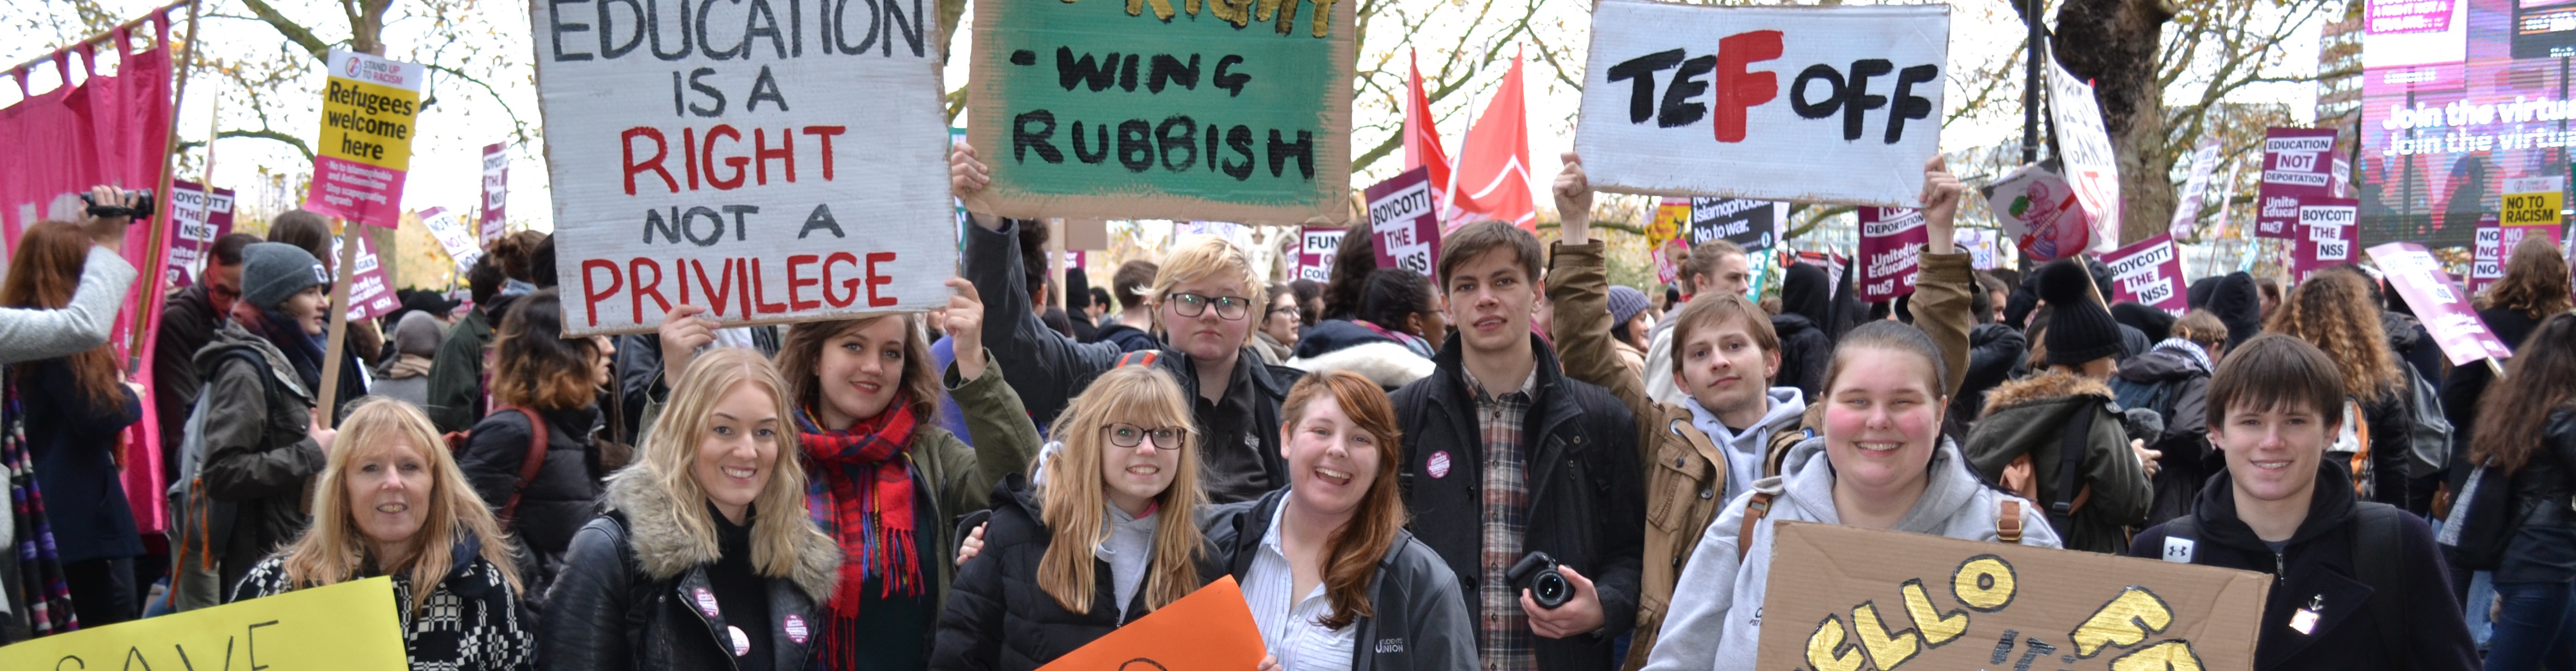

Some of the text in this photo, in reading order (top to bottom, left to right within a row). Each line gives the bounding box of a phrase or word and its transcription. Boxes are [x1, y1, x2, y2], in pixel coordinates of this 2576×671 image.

[550, 0, 925, 62] EDUCATION
[363, 60, 400, 74] STAND UP
[363, 70, 402, 85] TO RACISM
[328, 81, 413, 116] Refugees
[673, 64, 789, 117] IS A
[2382, 101, 2442, 130] Join
[2445, 100, 2494, 126] the
[328, 110, 407, 140] welcome
[342, 133, 384, 160] here
[1013, 109, 1315, 181] RUBBISH
[2269, 140, 2329, 150] EDUCATION
[621, 124, 846, 195] RIGHT
[2280, 155, 2313, 168] NOT
[2266, 173, 2325, 183] DEPORTATION
[173, 192, 229, 209] OYCOTT
[1373, 189, 1426, 225] BOYCOTT
[2507, 196, 2545, 209] NO TO
[178, 208, 202, 221] THE
[2262, 206, 2298, 218] Educat
[2302, 210, 2353, 221] BOYCOTT
[2506, 209, 2554, 223] RACISM
[184, 225, 212, 239] NSS
[643, 204, 845, 247] NOT A
[1694, 219, 1750, 244] No to war.
[1866, 214, 1924, 234] DEPORTATION
[2313, 227, 2336, 238] THE
[1308, 235, 1342, 249] FUN
[1387, 228, 1410, 249] THE
[2479, 230, 2499, 242] NO
[2504, 229, 2523, 241] NO
[2321, 245, 2343, 256] NSS
[2479, 246, 2498, 257] NO
[1399, 251, 1427, 272] NSS
[2111, 246, 2168, 276] BOYCOTT
[2477, 264, 2497, 275] NO
[2127, 271, 2154, 288] THE
[582, 252, 898, 327] PRIVILEGE
[2141, 283, 2168, 303] NSS
[1795, 554, 2018, 671] ELLO
